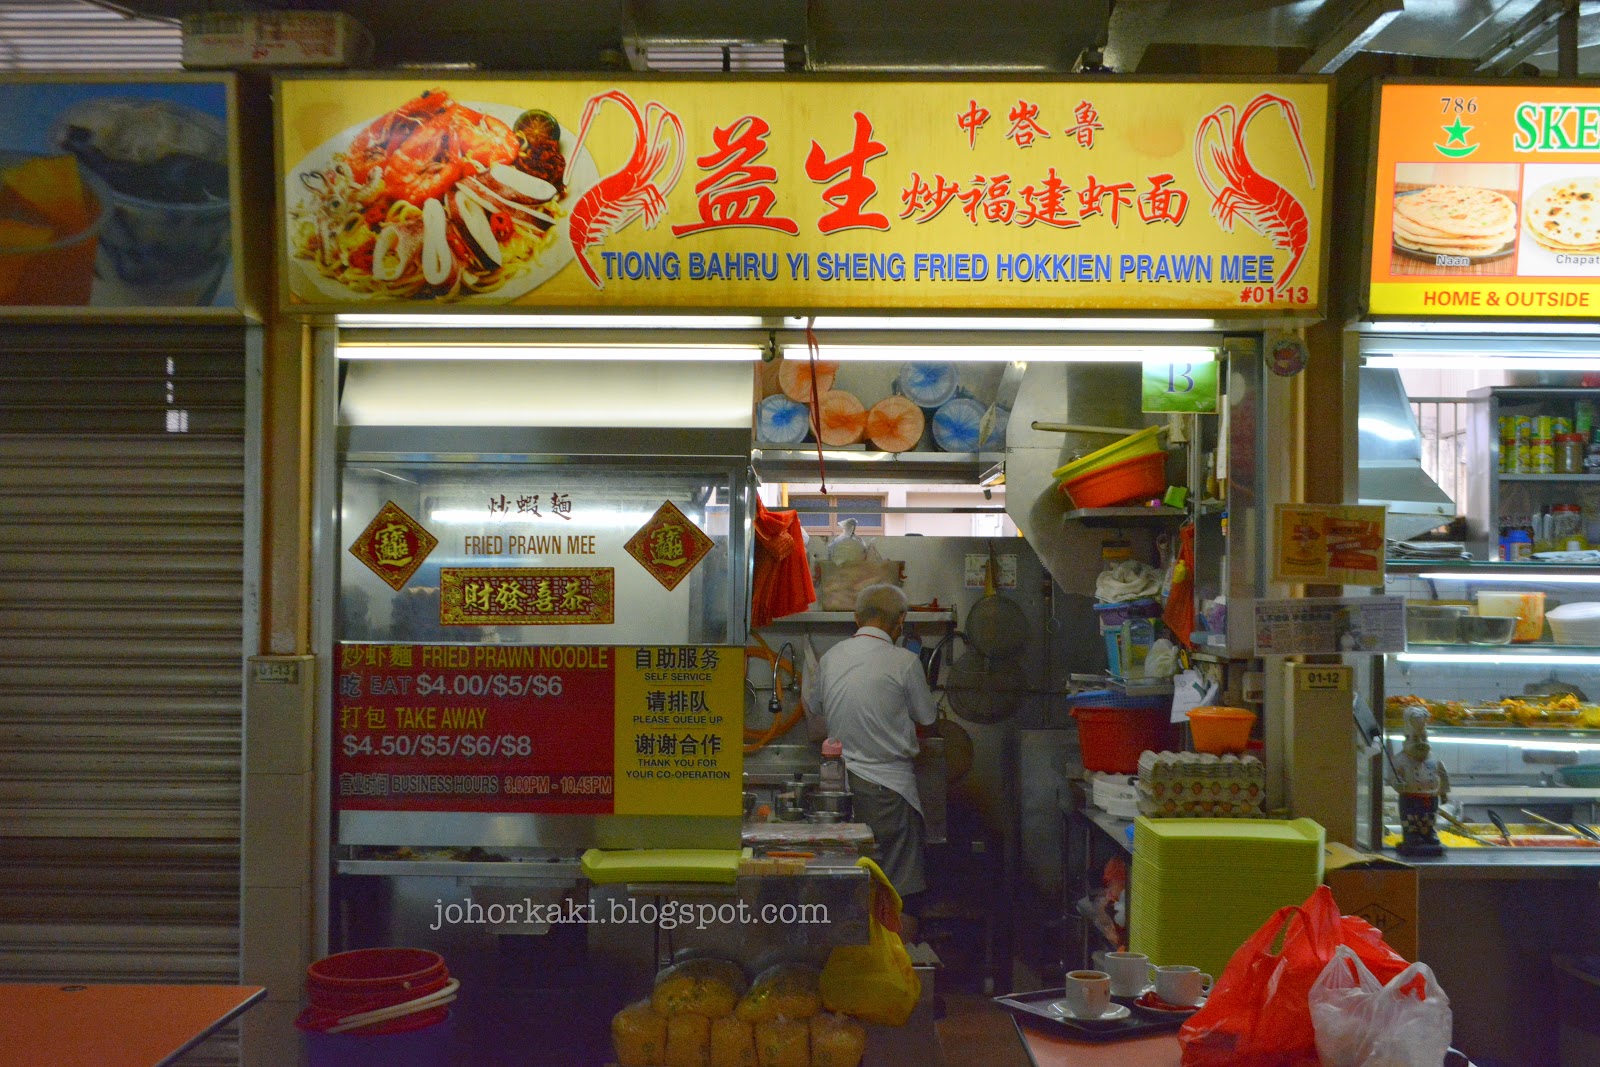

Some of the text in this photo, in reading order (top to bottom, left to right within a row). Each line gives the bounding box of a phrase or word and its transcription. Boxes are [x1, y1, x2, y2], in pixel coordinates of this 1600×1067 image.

[1441, 97, 1477, 114] 786
[671, 110, 892, 238] 益生
[899, 167, 1189, 228] 炒福建虾面
[601, 252, 1275, 282] TIONG BAHRU YI SHENG FRIED HOKKIEN PRAWN MEE
[1436, 255, 1470, 266] Naan
[1239, 286, 1309, 304] #01-13
[1424, 291, 1590, 307] HOME & OUTSIDE
[464, 535, 596, 555] FRIED PRAWN MEE
[422, 647, 470, 668] FRIED
[475, 647, 535, 669] PRAWN
[539, 647, 608, 669] NOODLE
[635, 647, 720, 669] 自助服务
[340, 674, 563, 697] 吃 EAT $4.00/$5/$6
[644, 672, 712, 681] SELF SERVICE
[1308, 672, 1339, 683] 01-12
[646, 691, 710, 713] 请排队
[340, 706, 487, 730] 打包 TAKE AWAY
[633, 715, 723, 725] PLEASE QUEUE UP
[343, 734, 532, 758] $4.50/$5/$6/$8
[634, 733, 722, 756] 谢谢合作
[637, 758, 717, 768] THANK YOU FOR
[391, 775, 453, 794] BUSINESS
[455, 775, 498, 793] HOURS
[626, 770, 730, 780] YOUR CO-OPERATION
